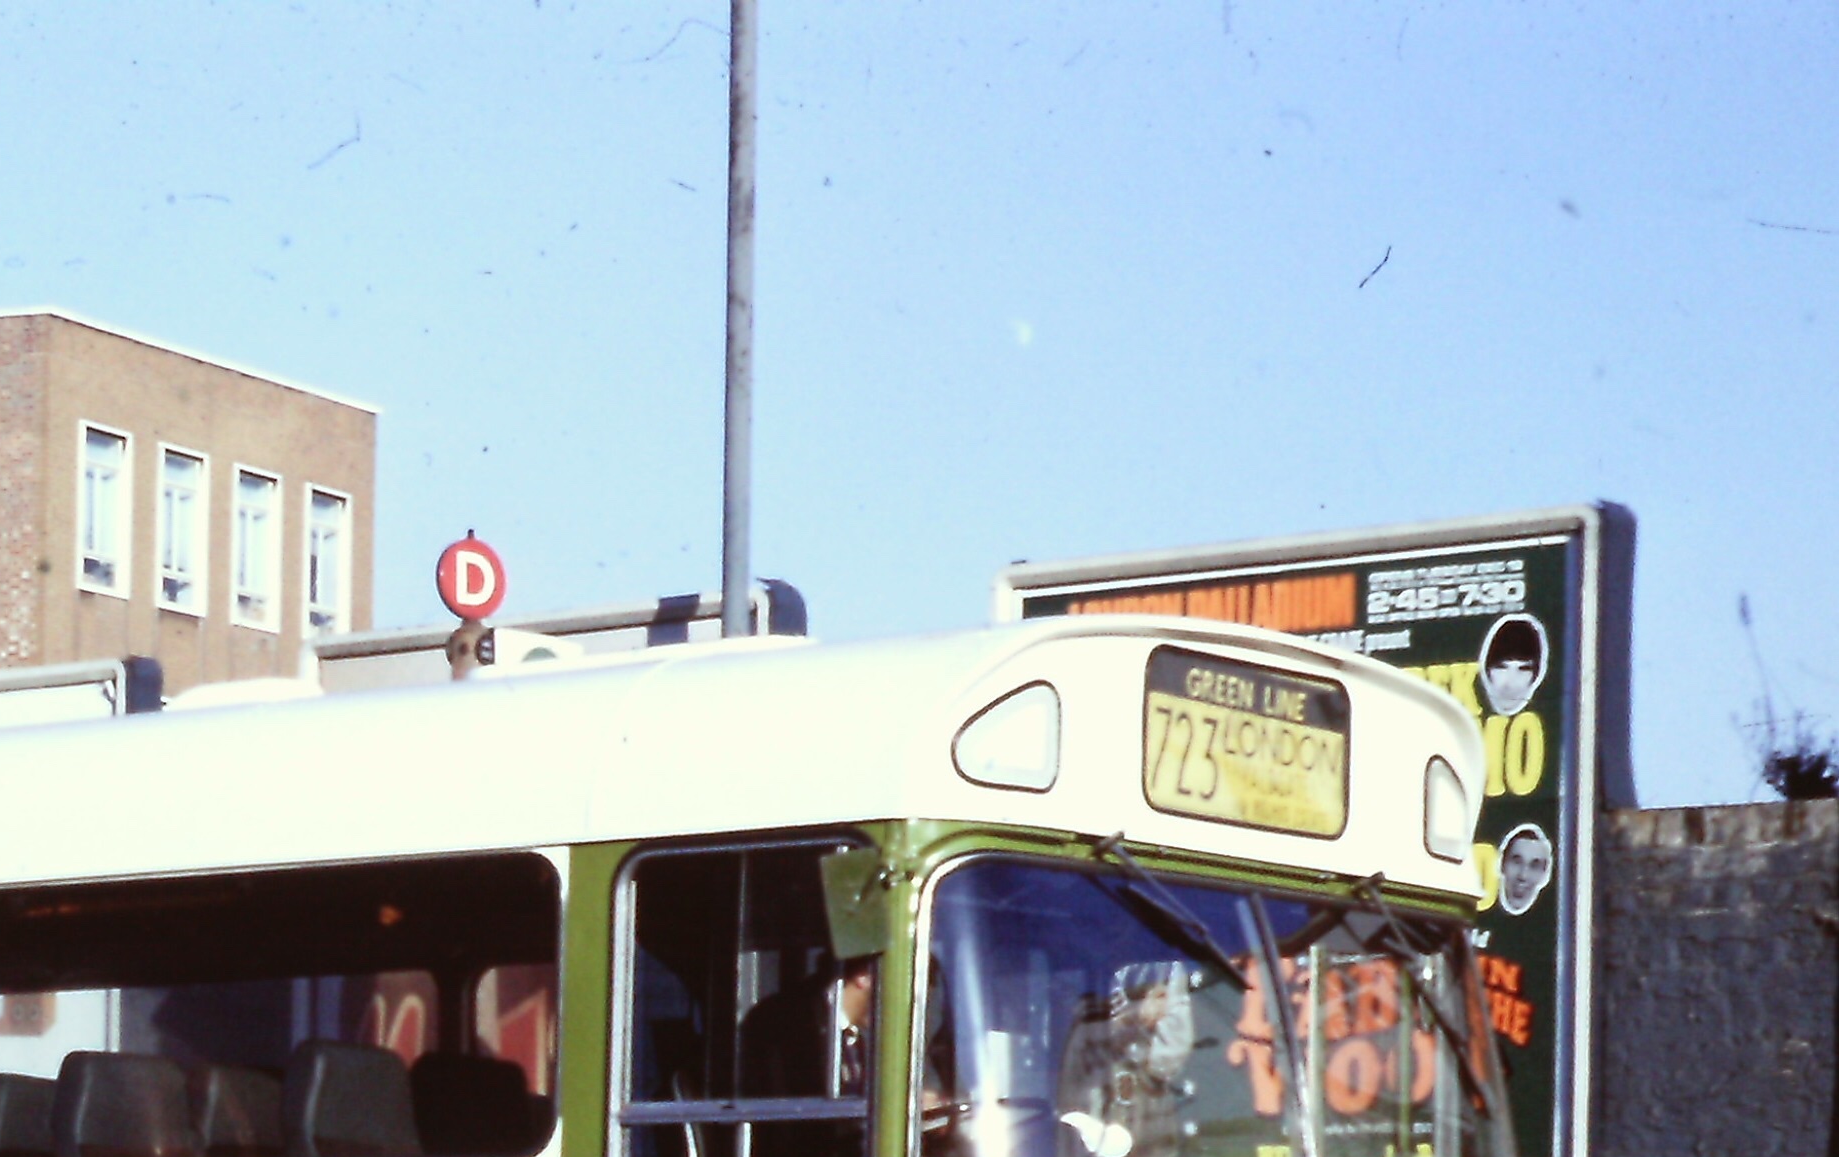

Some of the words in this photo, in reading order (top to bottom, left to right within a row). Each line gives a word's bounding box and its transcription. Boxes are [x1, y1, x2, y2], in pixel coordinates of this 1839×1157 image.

[455, 549, 496, 606] D
[1186, 666, 1256, 709] GREEN
[1263, 685, 1308, 722] LINE
[1151, 706, 1219, 801] 723
[1224, 712, 1344, 777] LONDON
